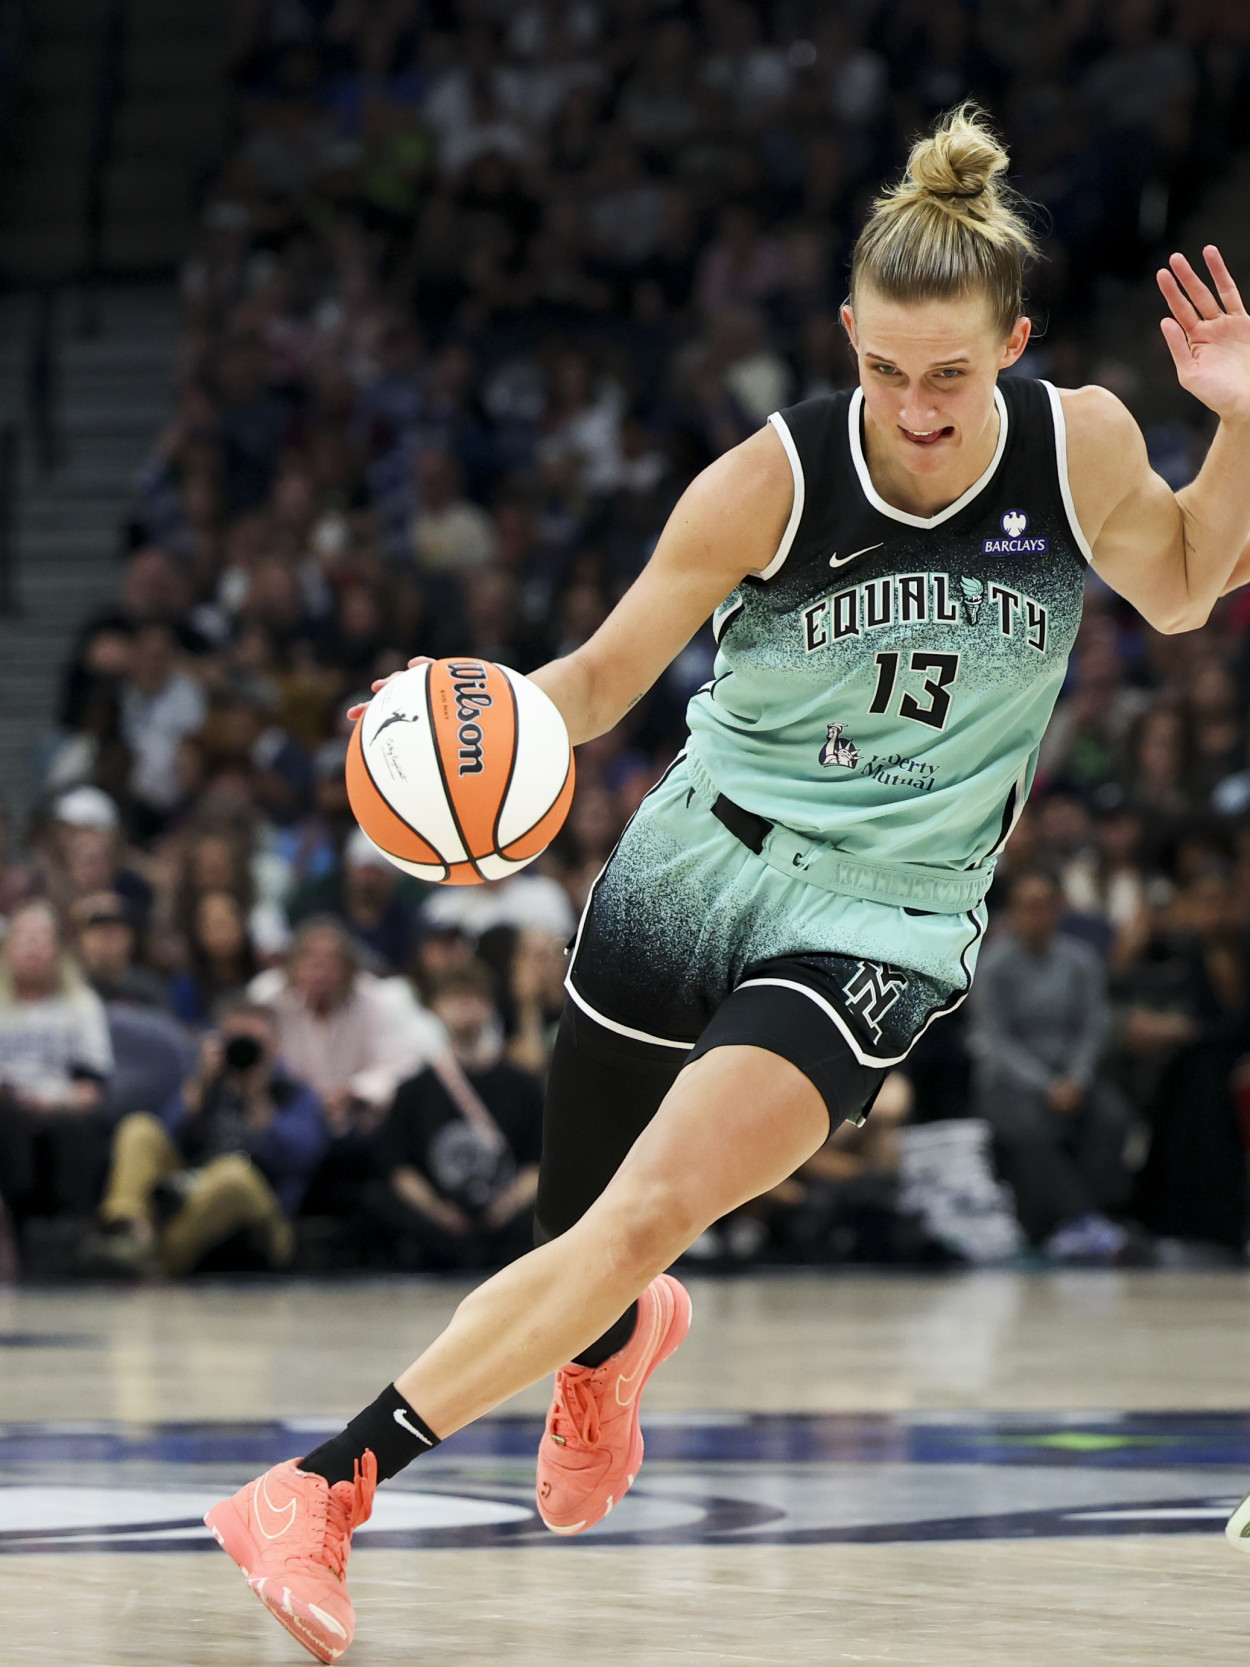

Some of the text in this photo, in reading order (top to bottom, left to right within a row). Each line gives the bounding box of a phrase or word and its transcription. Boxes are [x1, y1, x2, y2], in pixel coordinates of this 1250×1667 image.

[985, 539, 1045, 553] BARCLAYS
[447, 661, 493, 777] Wilson
[867, 650, 962, 732] 13
